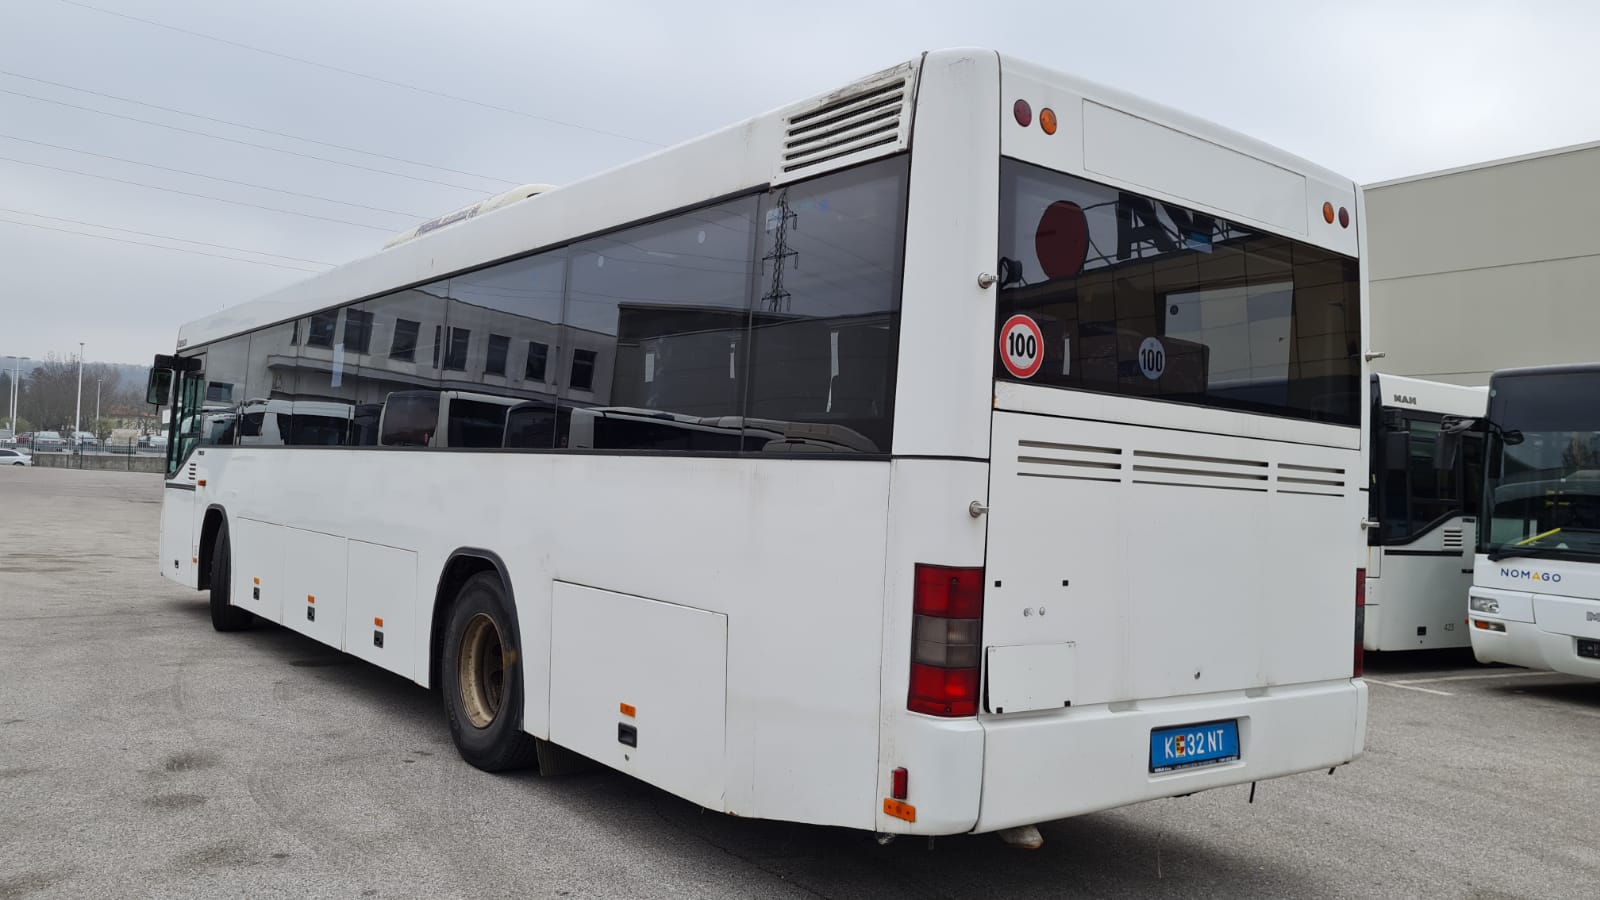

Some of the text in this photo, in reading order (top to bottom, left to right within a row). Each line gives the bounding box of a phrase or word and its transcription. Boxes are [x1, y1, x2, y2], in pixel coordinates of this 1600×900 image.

[1008, 332, 1036, 359] 100
[1141, 347, 1163, 372] 100
[1393, 394, 1417, 405] MAN
[1500, 567, 1562, 583] NOMAGO
[1165, 737, 1174, 759] K
